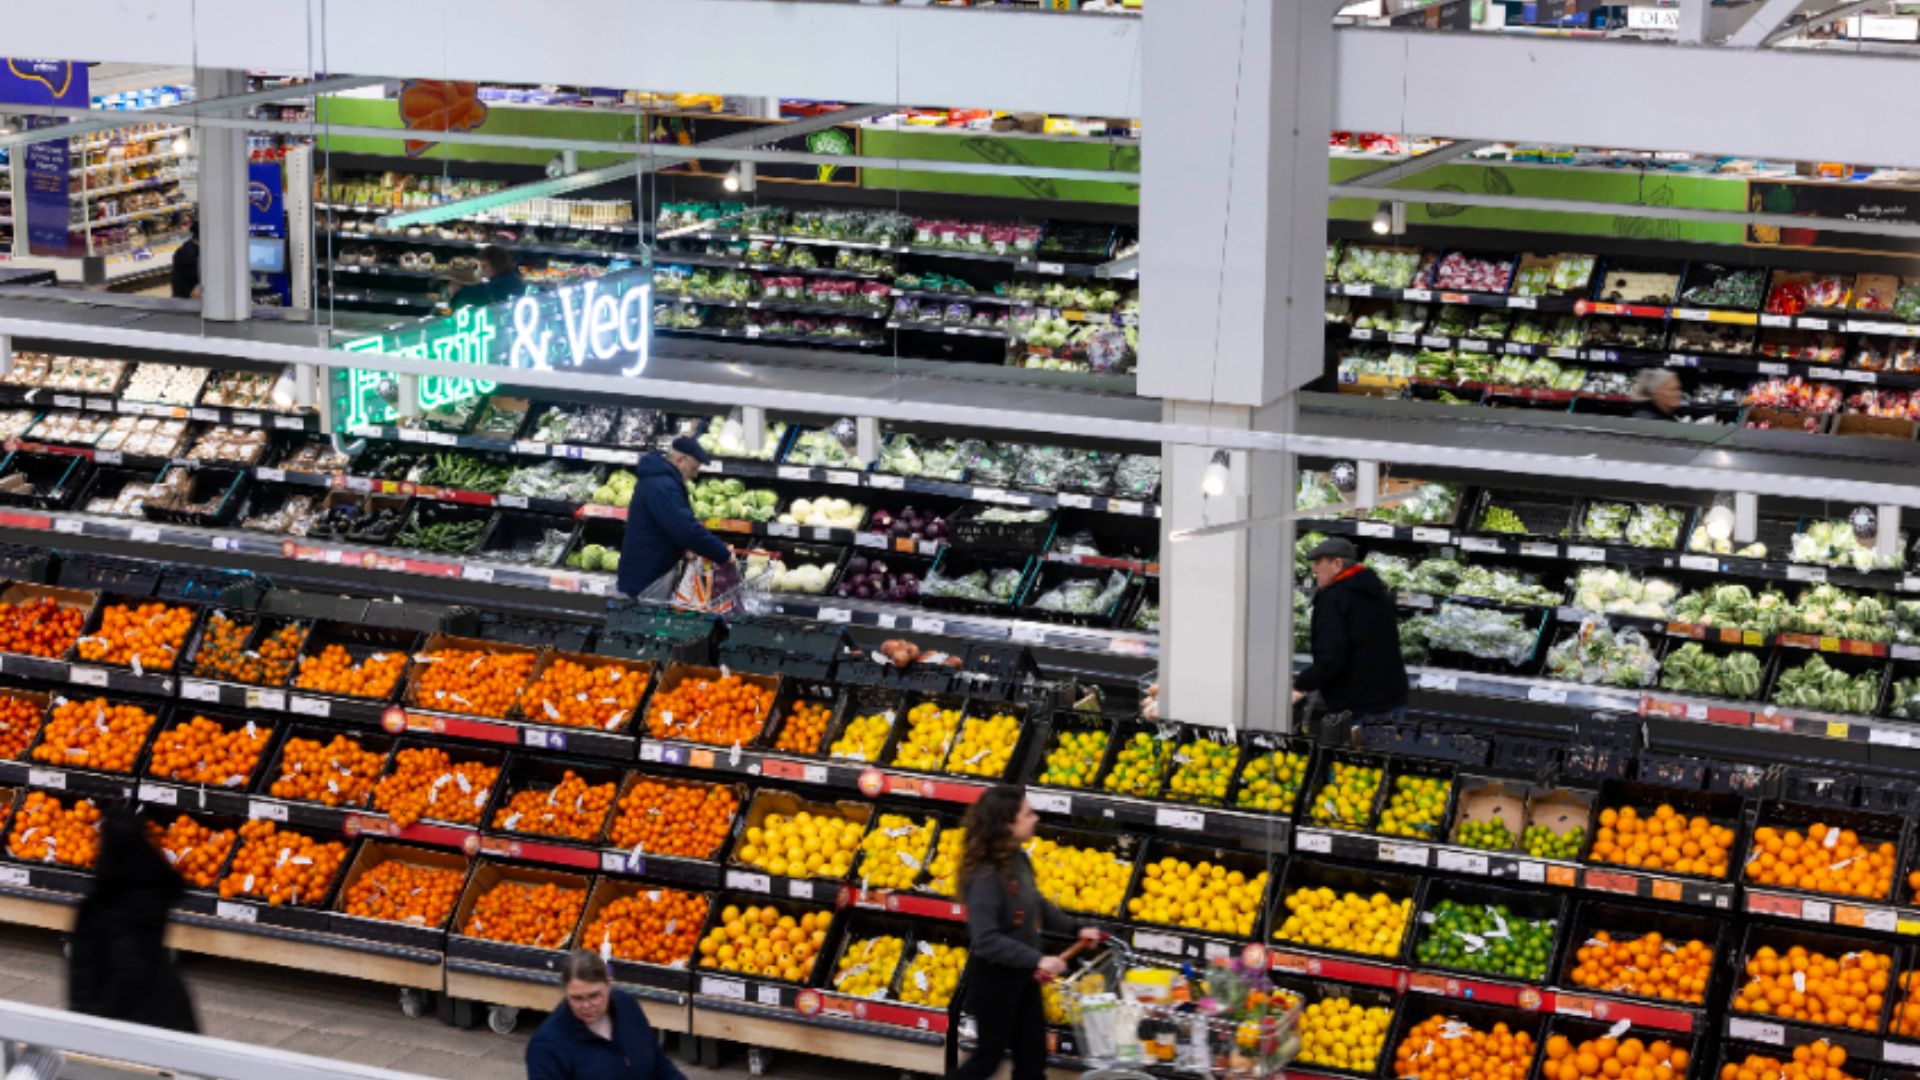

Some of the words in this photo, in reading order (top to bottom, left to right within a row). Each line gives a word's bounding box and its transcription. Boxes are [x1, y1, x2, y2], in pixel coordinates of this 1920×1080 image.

[344, 306, 497, 434] Fuit
[509, 296, 553, 372] &
[558, 279, 651, 378] Veg
